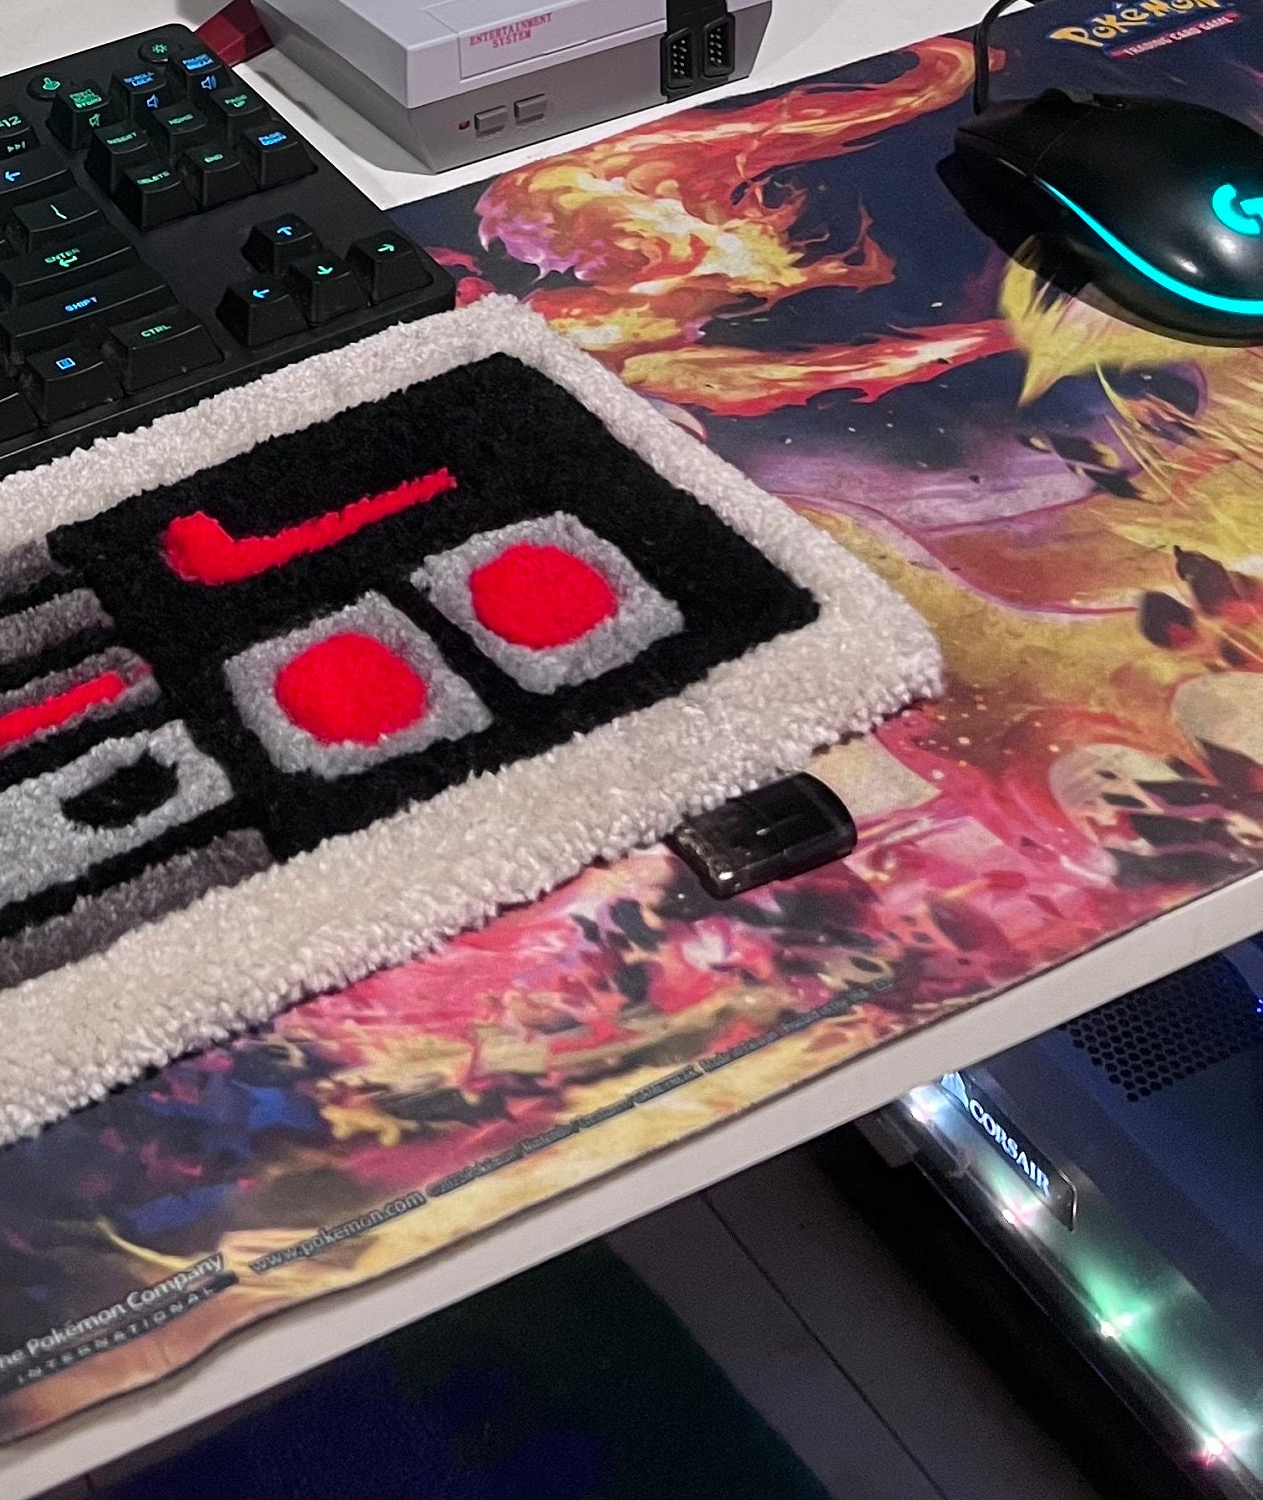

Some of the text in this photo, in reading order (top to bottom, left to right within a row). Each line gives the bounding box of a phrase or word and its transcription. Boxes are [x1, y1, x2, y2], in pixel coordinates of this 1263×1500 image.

[469, 11, 553, 47] ENTERTAINMENT
[491, 29, 532, 49] SYSTEM
[45, 248, 80, 264] ENTER
[64, 296, 98, 312] SHIFT
[140, 324, 172, 337] CTRL
[969, 1099, 1051, 1198] CORSAIR
[251, 1191, 425, 1273] www.pokemon.com
[25, 1303, 129, 1358] Pokémon
[126, 1255, 224, 1311] Company
[16, 1286, 216, 1385] INTERNATIONAL
